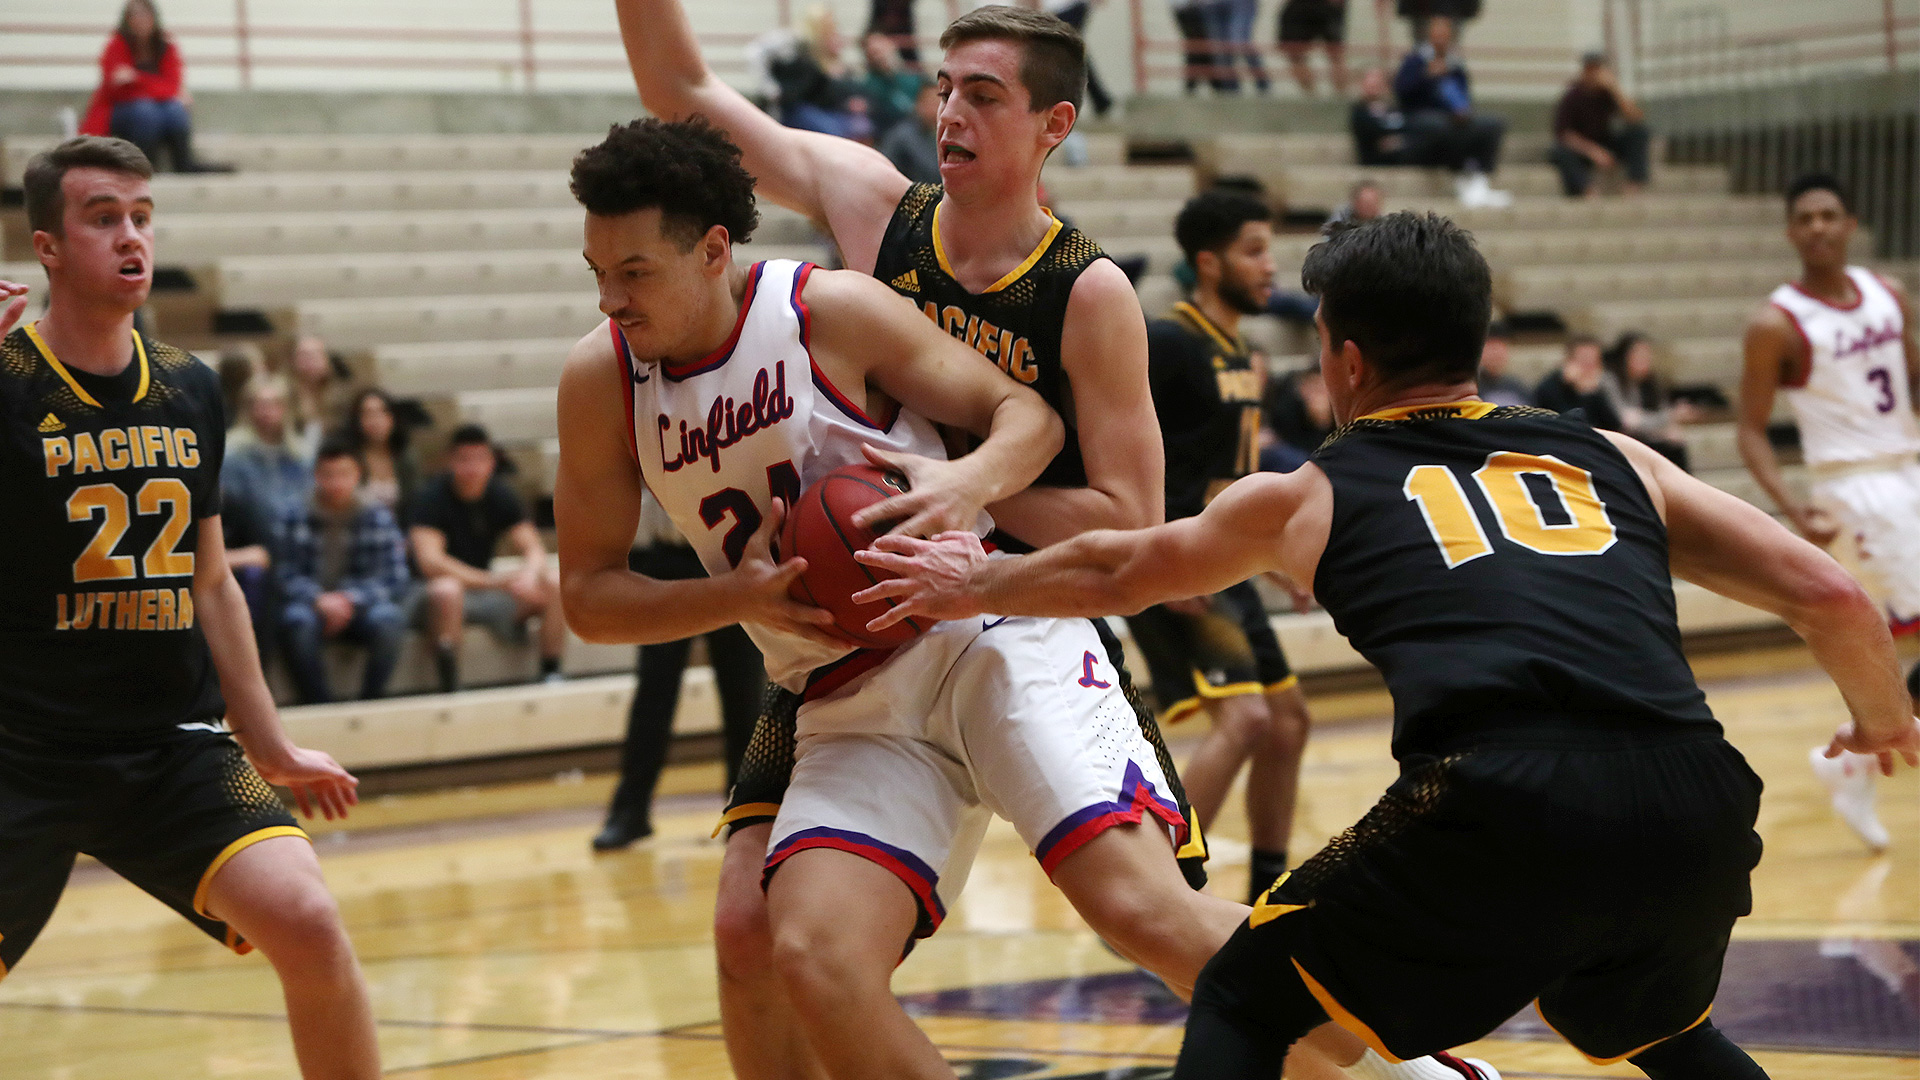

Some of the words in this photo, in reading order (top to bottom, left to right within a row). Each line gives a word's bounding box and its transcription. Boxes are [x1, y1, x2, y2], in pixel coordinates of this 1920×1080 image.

[891, 278, 922, 293] adidas
[658, 360, 794, 473] Linfield
[1867, 367, 1896, 414] 3
[42, 425, 200, 478] PACIFIC
[66, 478, 195, 583] 22
[1402, 450, 1619, 570] 10
